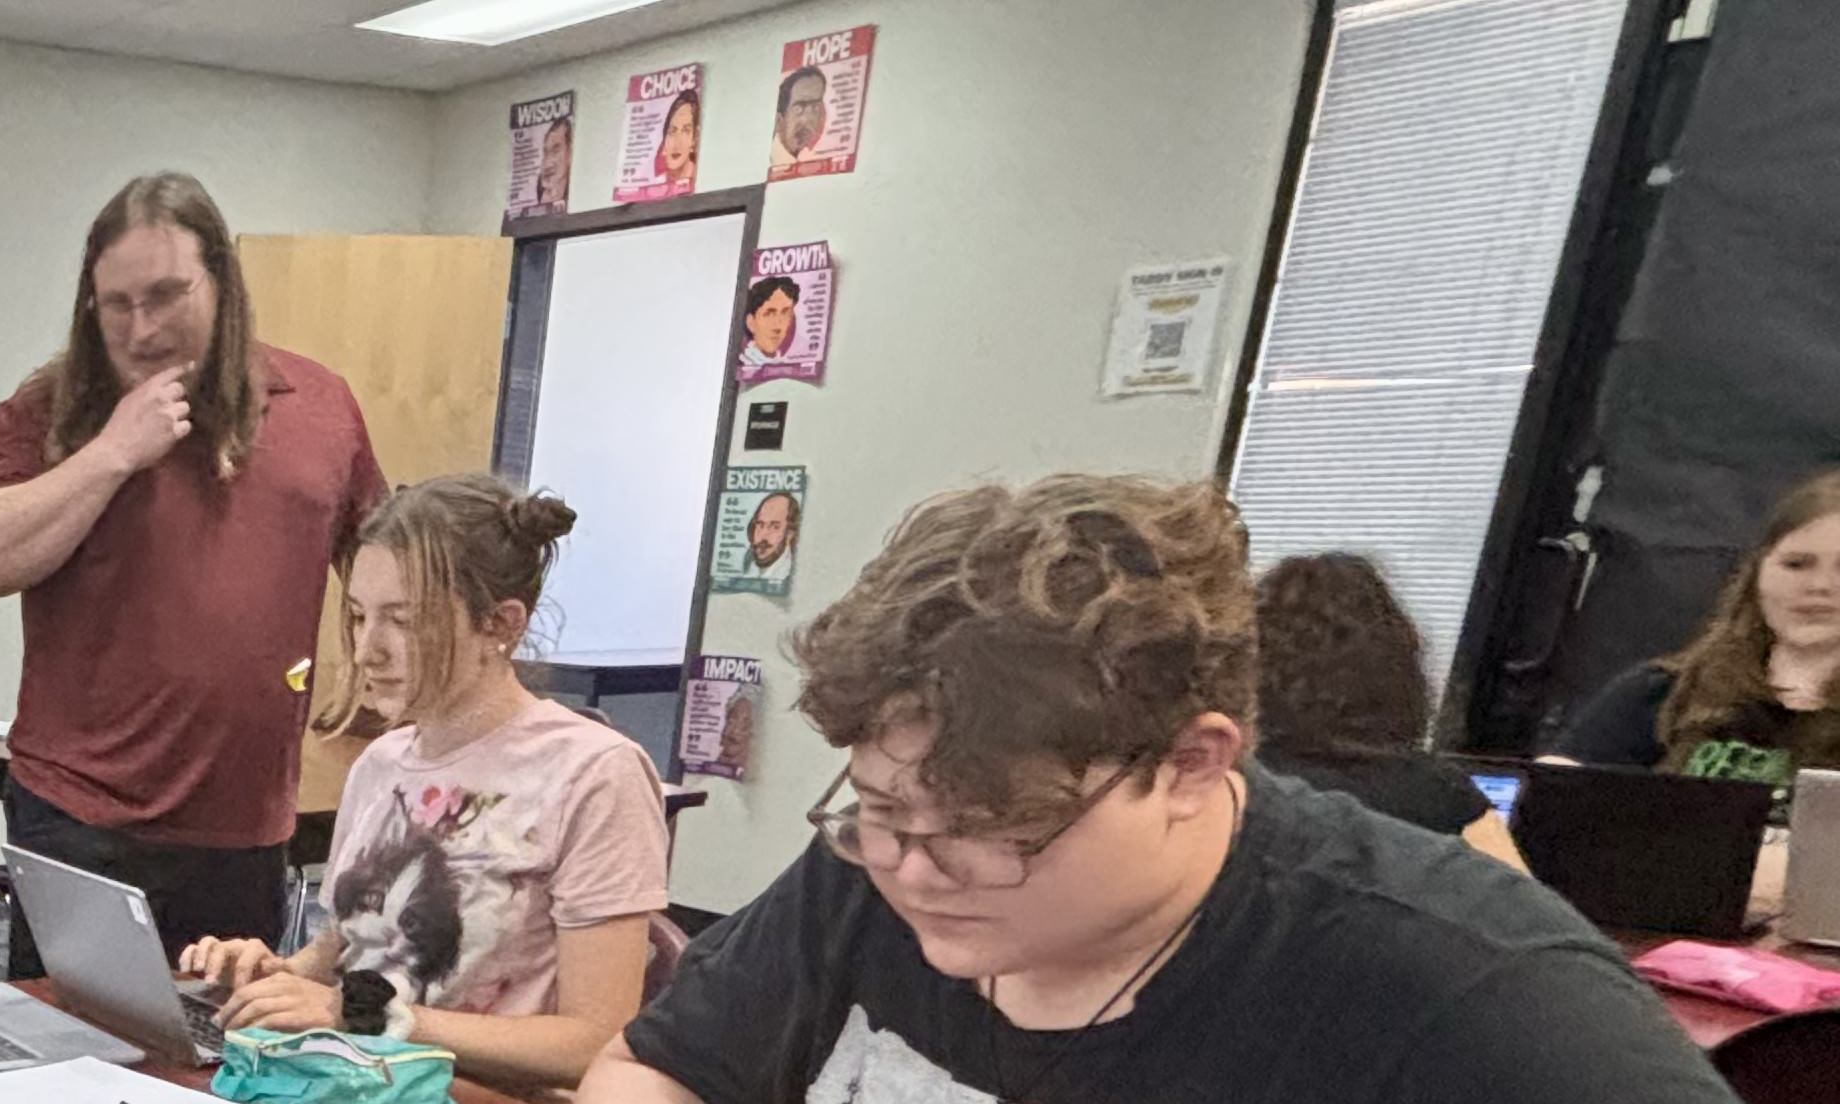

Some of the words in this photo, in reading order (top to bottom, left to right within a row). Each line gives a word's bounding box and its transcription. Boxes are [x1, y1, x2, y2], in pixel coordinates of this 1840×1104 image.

[803, 32, 852, 67] HOPE
[640, 65, 696, 99] CHOICE
[759, 244, 828, 275] GROWTH
[726, 468, 802, 491] EXISTENCE
[703, 657, 762, 684] IMPACT
